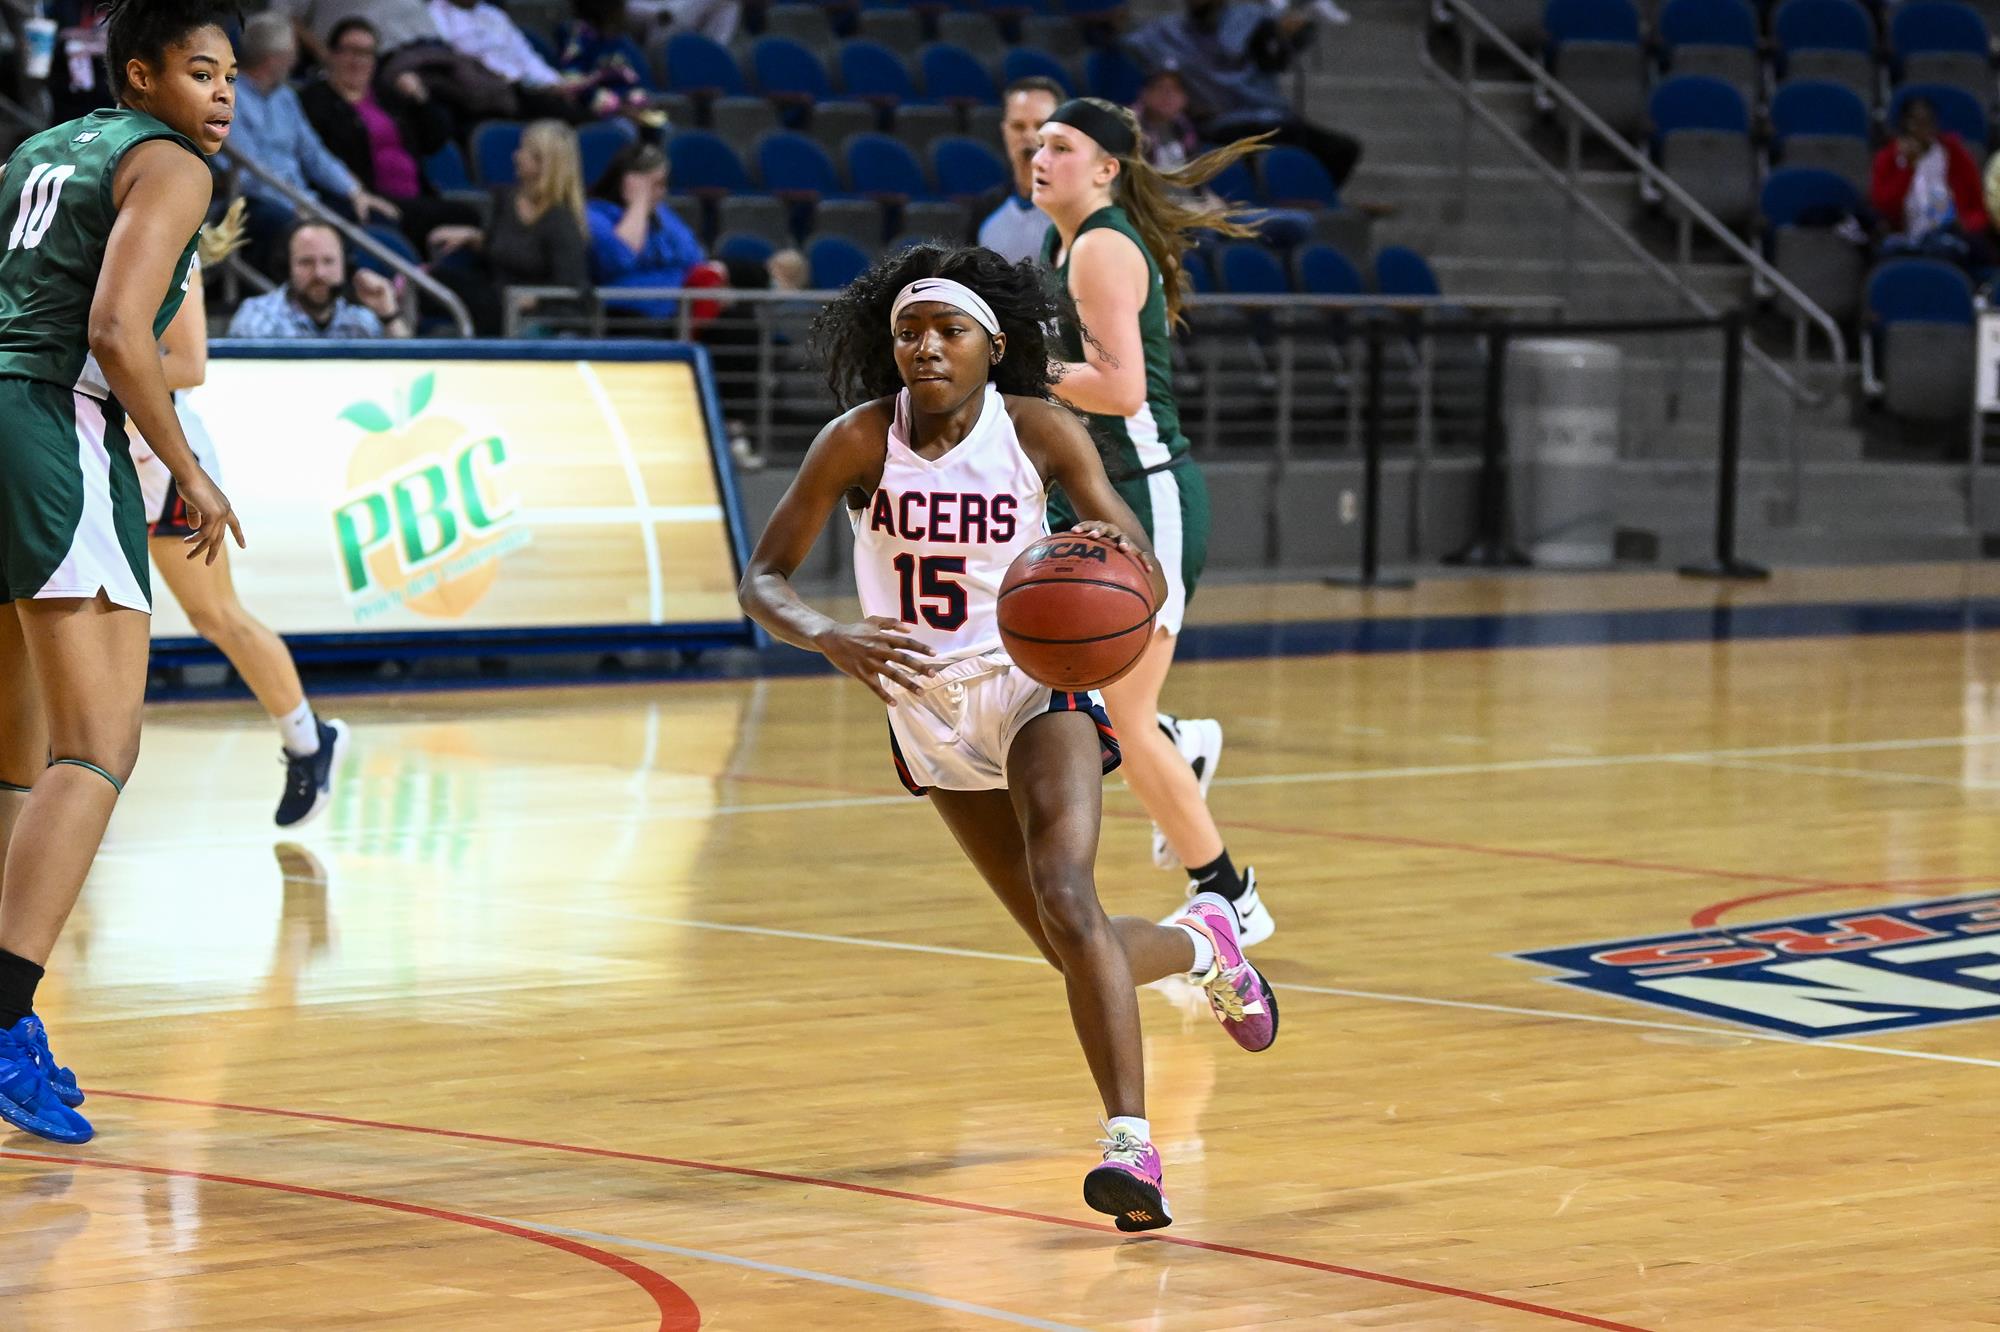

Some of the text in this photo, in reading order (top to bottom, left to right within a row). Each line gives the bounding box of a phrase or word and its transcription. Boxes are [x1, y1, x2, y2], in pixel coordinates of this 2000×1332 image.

[8, 163, 76, 250] 10
[334, 434, 513, 593] PBC
[865, 488, 1018, 544] ACERS
[893, 552, 969, 632] 15
